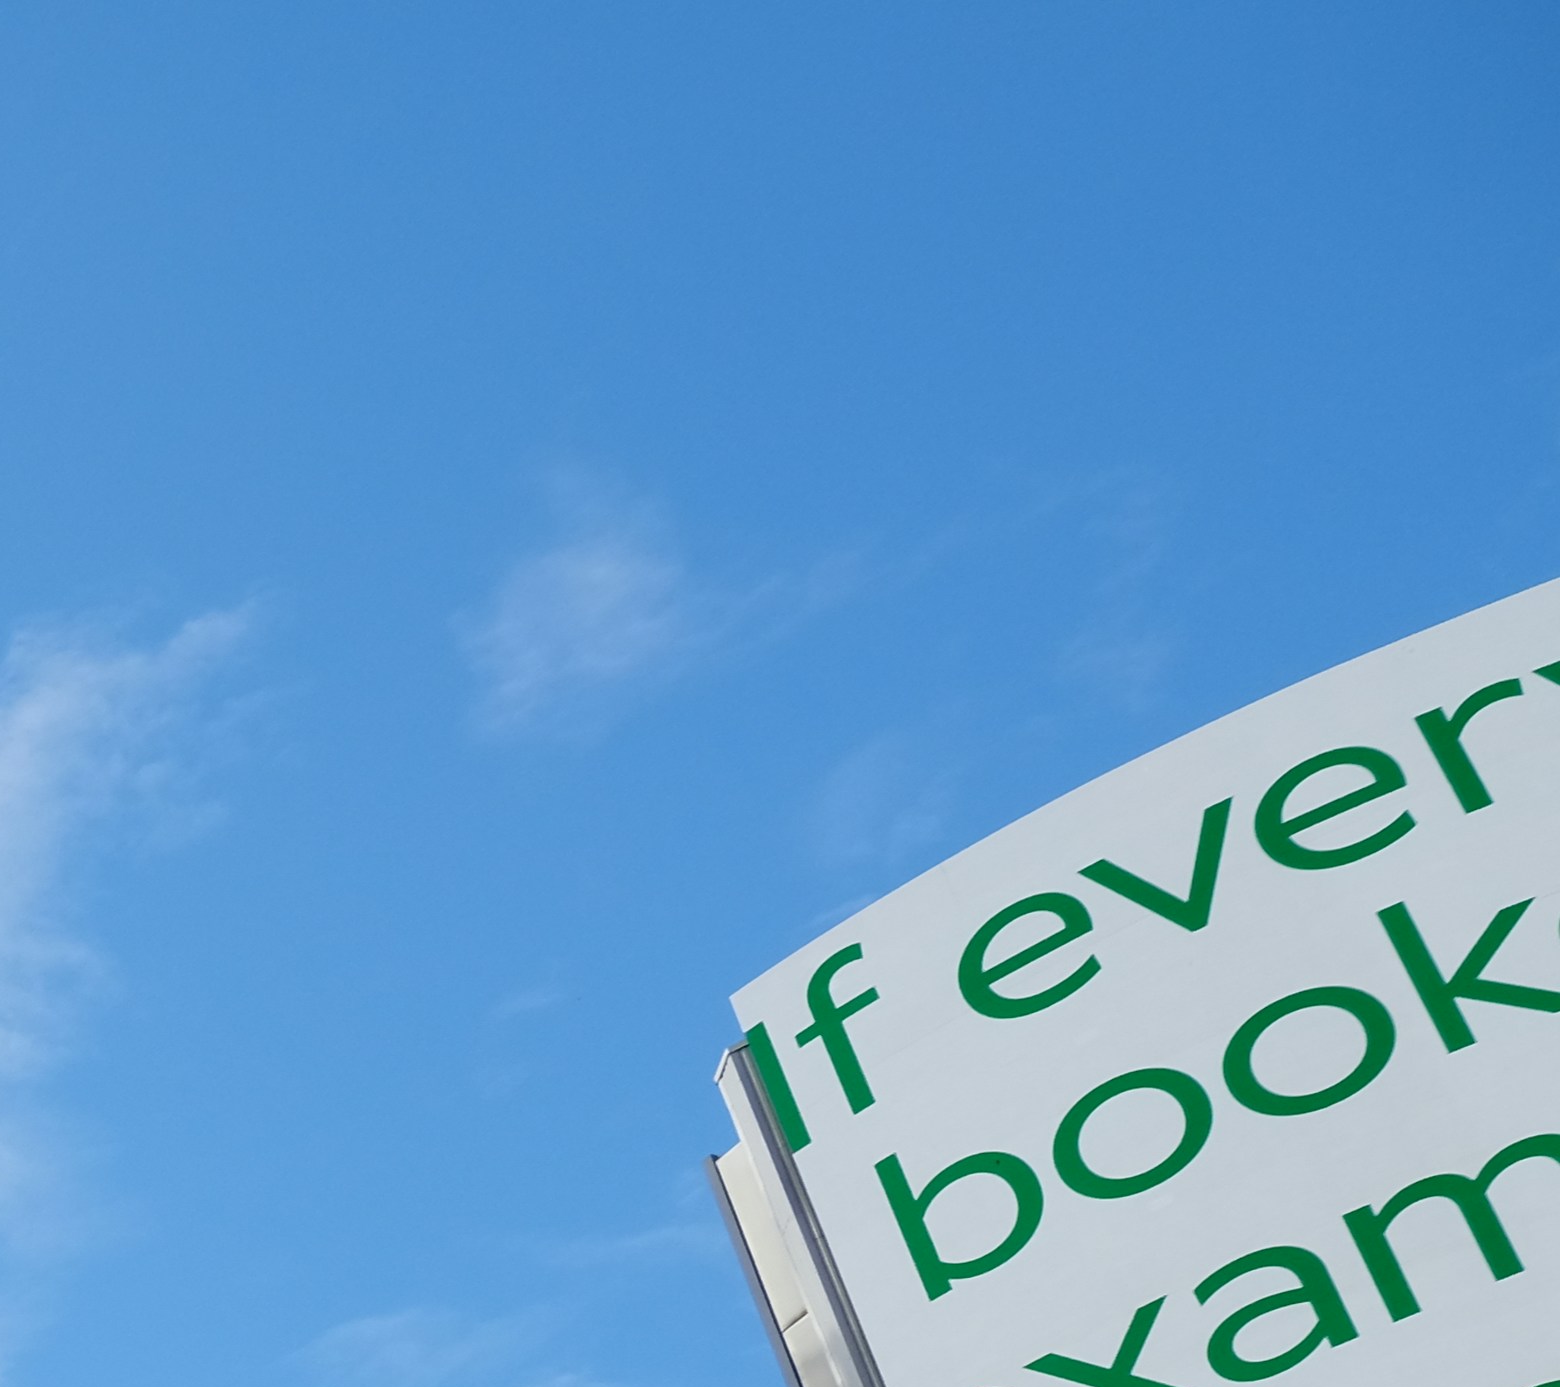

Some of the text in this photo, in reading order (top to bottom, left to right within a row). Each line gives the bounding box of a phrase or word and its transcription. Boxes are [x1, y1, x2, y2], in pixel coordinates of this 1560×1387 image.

[745, 660, 1560, 1155] If ever
[874, 896, 1560, 1302] book
